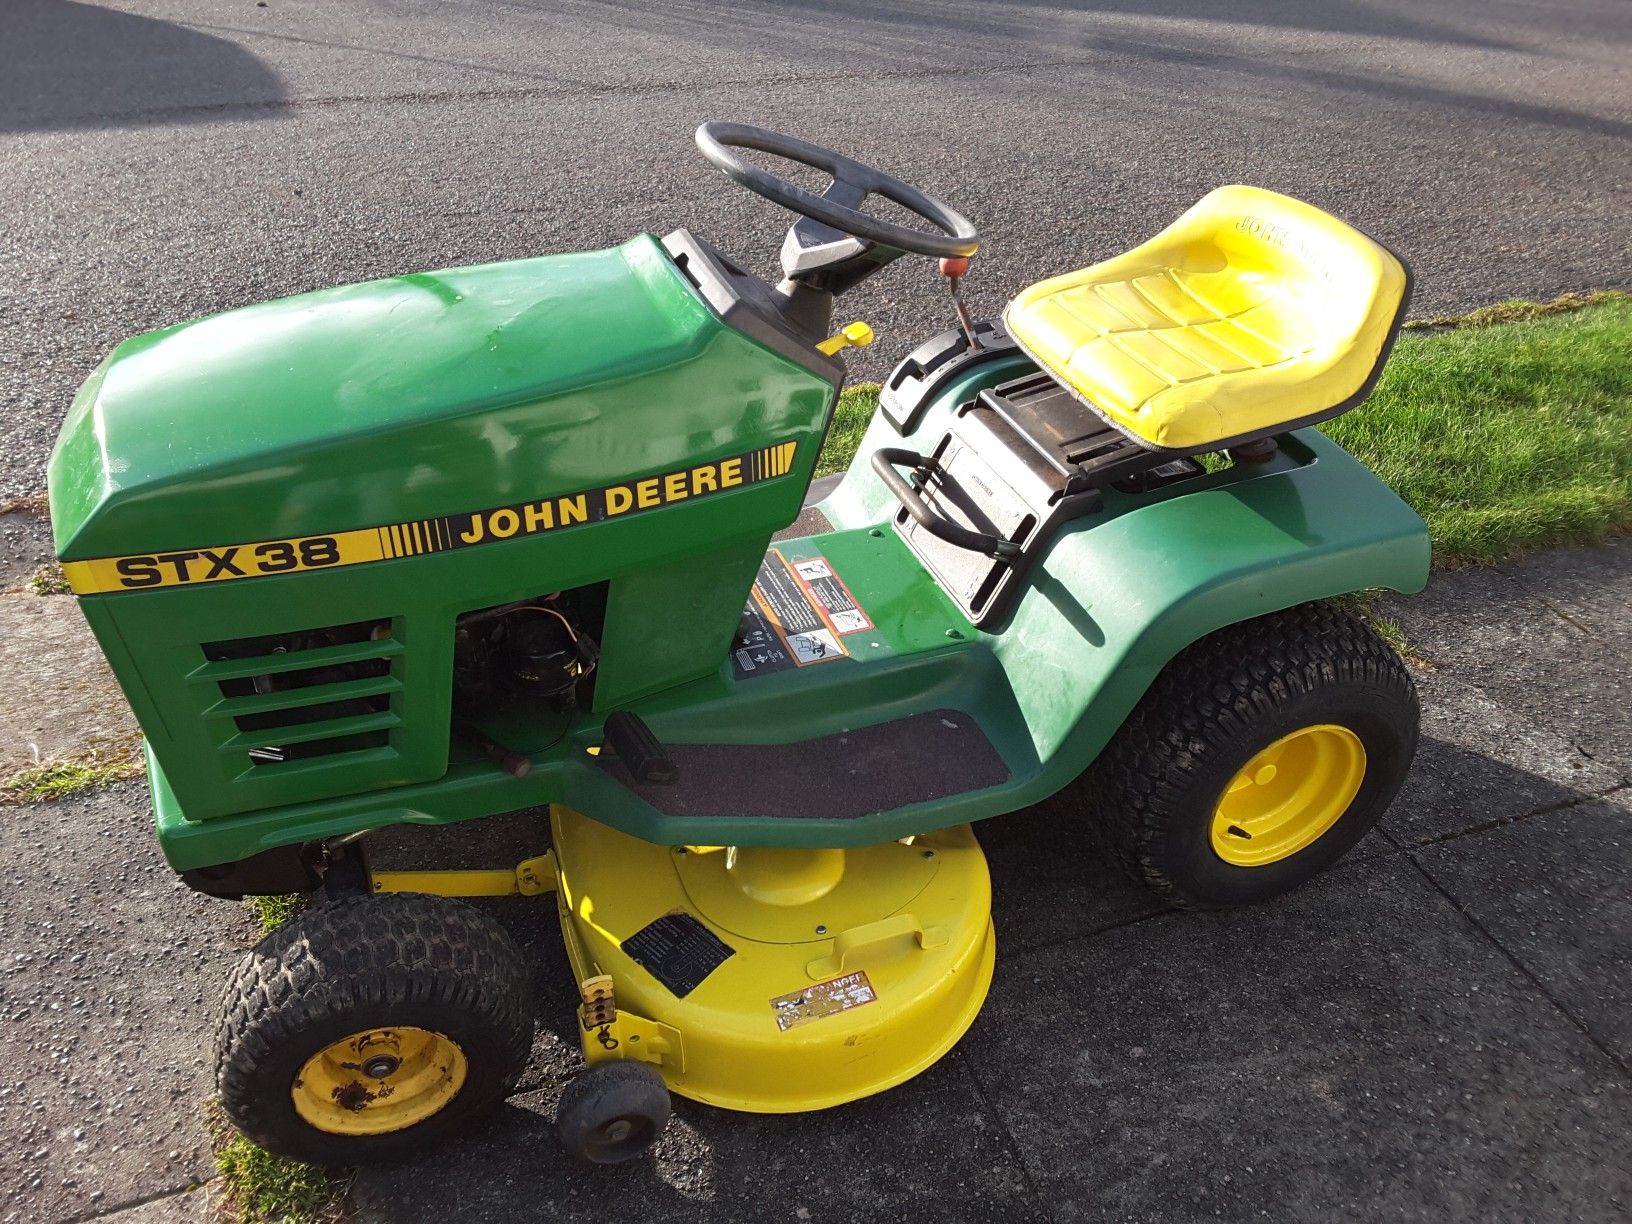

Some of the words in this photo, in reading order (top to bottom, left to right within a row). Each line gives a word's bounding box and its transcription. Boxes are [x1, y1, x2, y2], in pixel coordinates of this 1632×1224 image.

[1235, 214, 1290, 247] JOHN
[460, 494, 588, 544] JOHN
[605, 457, 743, 516] DEERE
[115, 547, 247, 588] STX
[254, 537, 341, 572] 38
